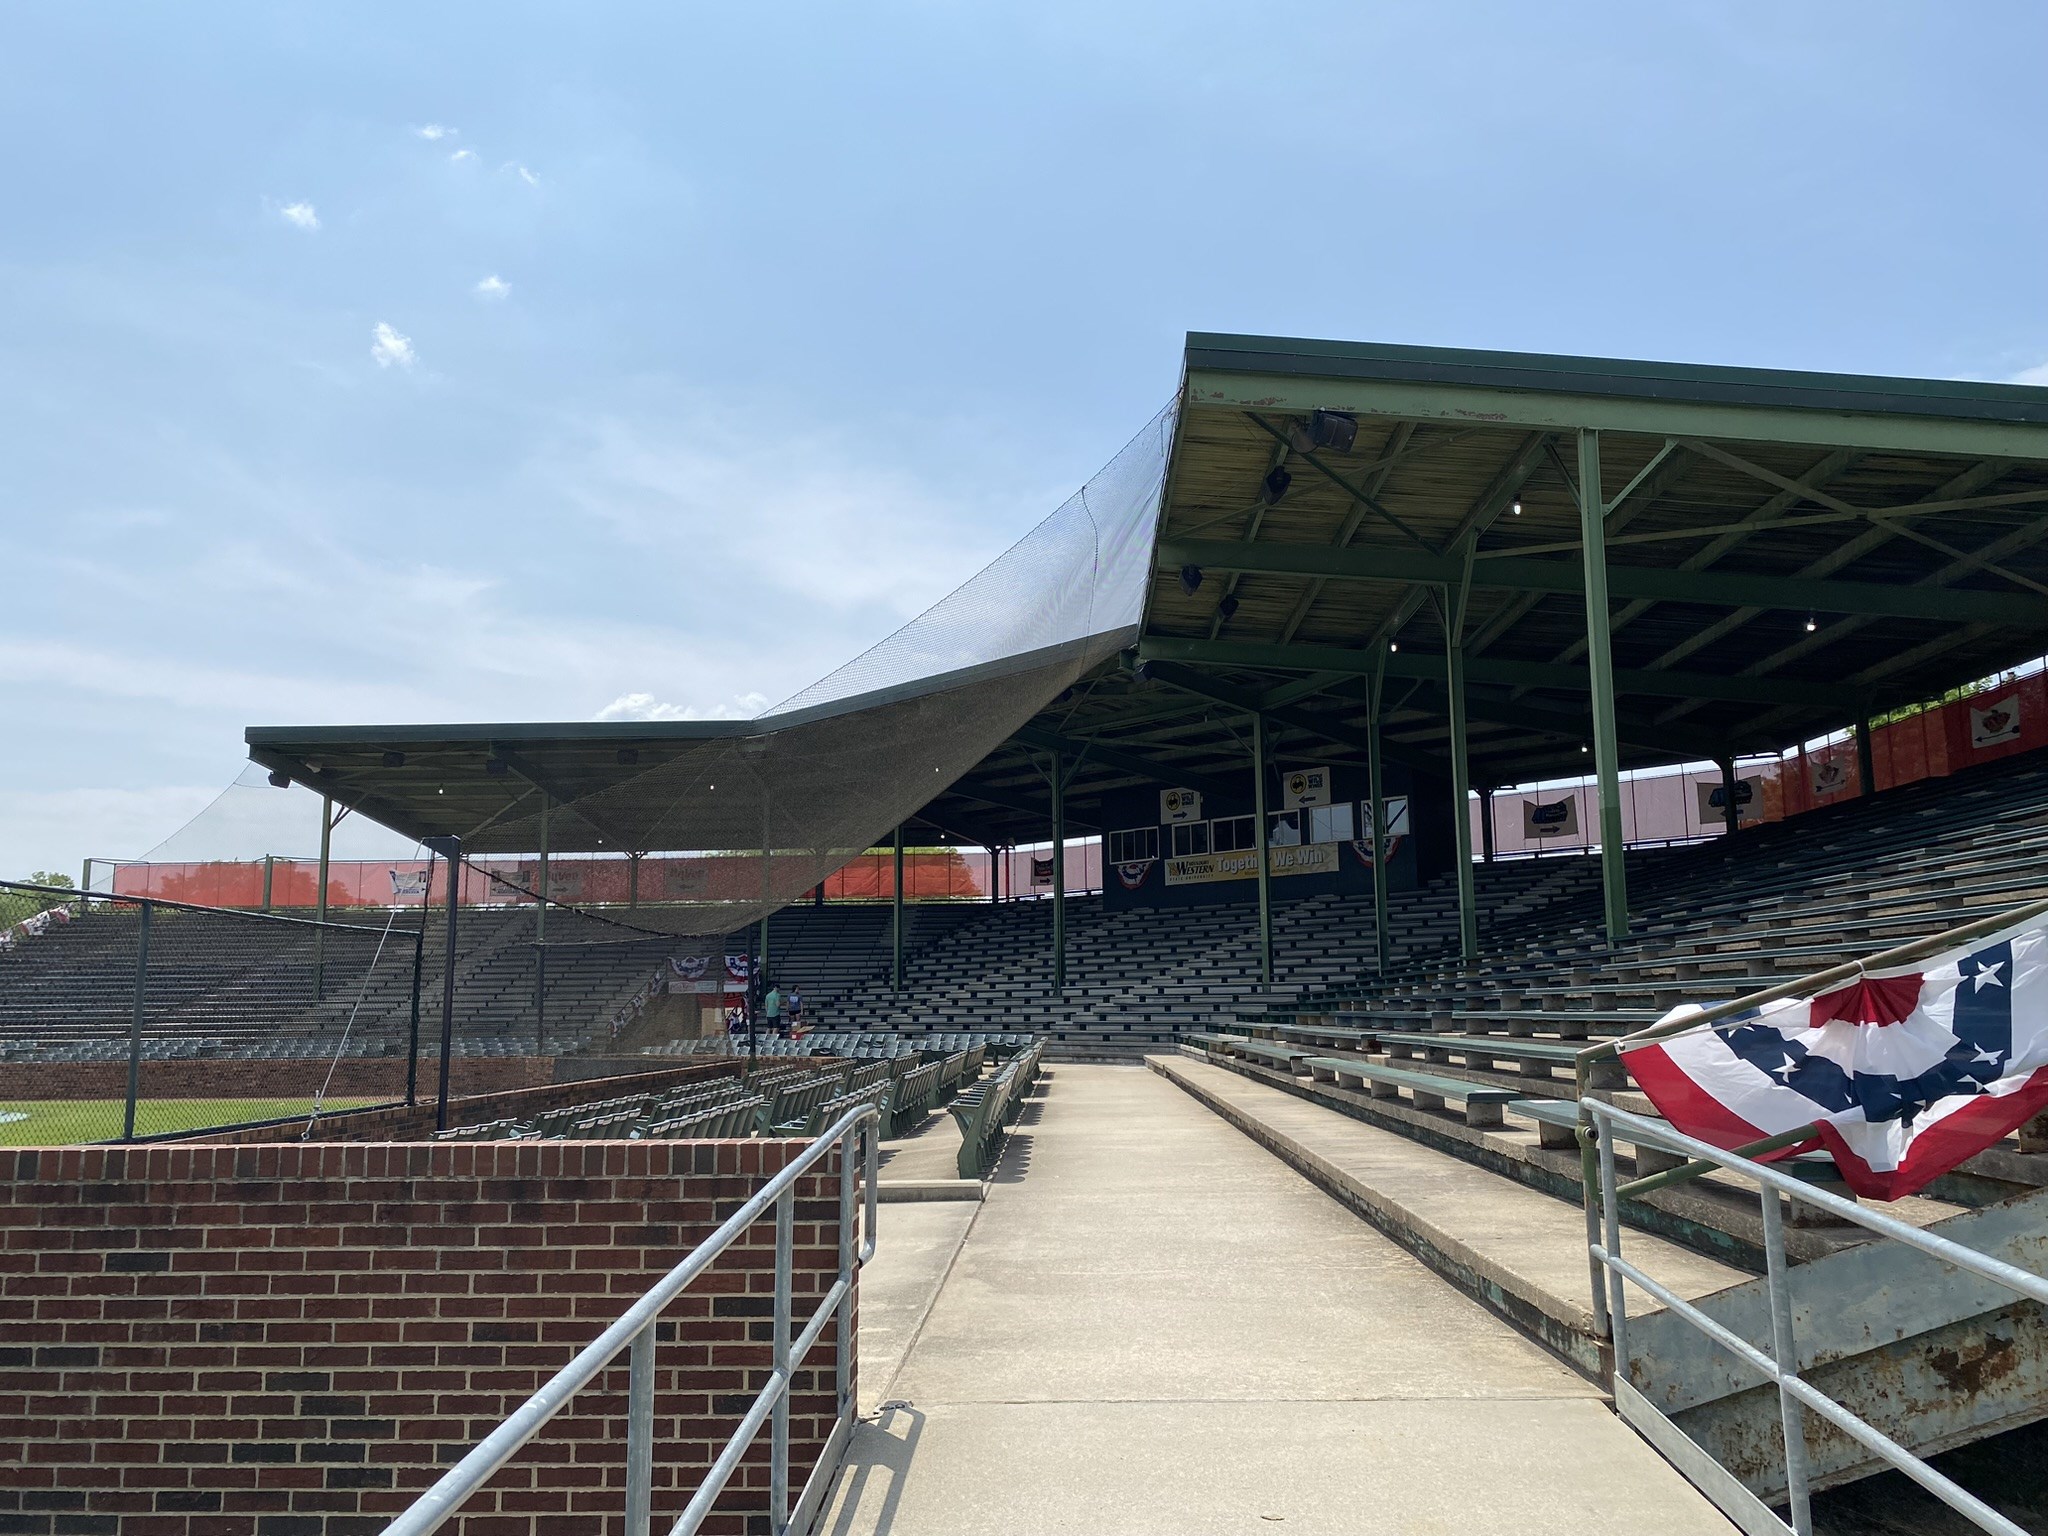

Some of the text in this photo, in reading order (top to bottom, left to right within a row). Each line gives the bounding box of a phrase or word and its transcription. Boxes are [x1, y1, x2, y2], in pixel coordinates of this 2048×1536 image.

[1176, 861, 1215, 876] WESTERN
[1217, 849, 1324, 874] Togeth We Win
